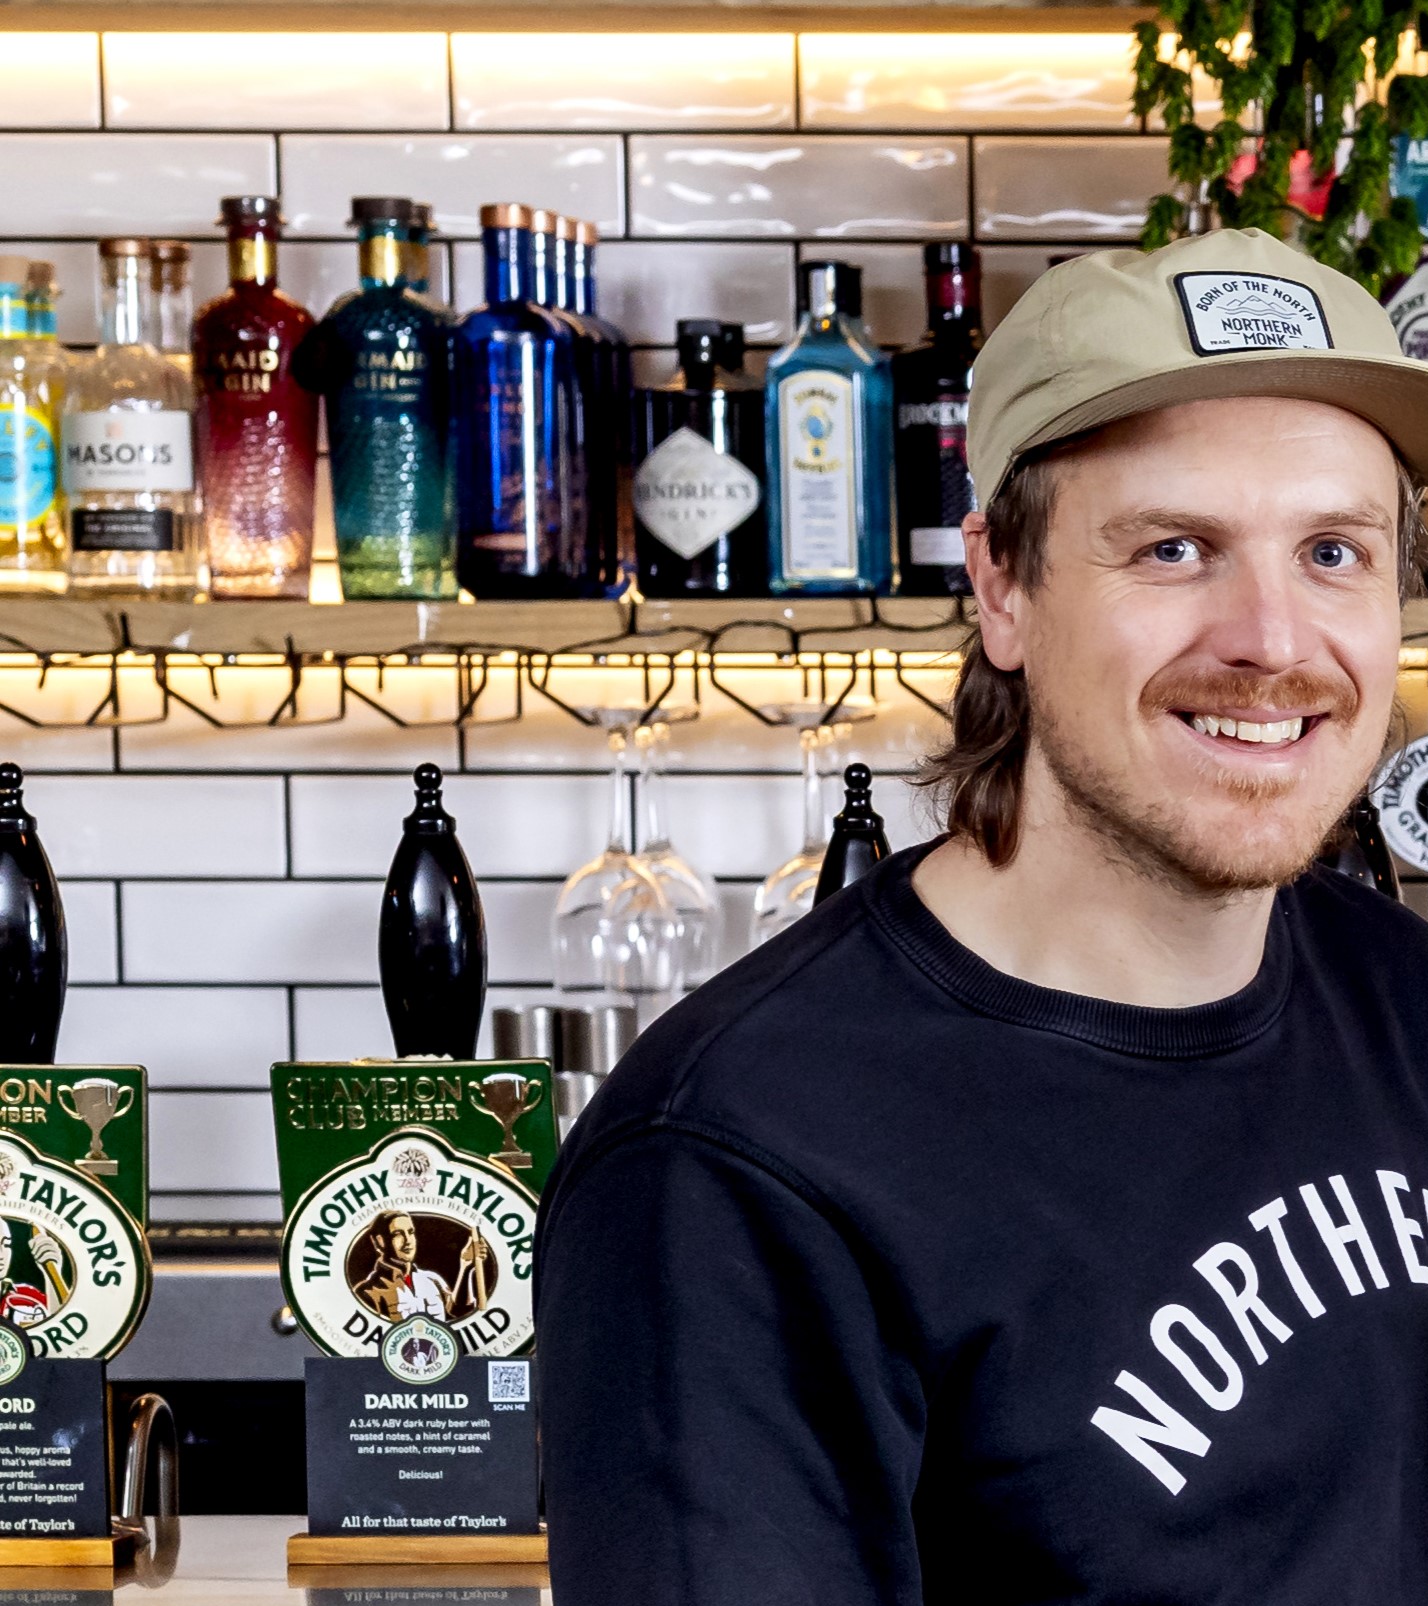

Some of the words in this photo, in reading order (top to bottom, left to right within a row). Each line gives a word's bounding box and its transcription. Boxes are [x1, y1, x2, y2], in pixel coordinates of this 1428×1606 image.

[1196, 286, 1224, 312] BORN
[1222, 281, 1239, 292] OF
[1242, 280, 1269, 293] THE
[1273, 288, 1316, 321] NORTH
[1221, 317, 1303, 336] NORTHERN
[1242, 332, 1289, 347] MONK
[287, 1076, 462, 1102] CHAMPION
[289, 1104, 366, 1129] CLUB
[372, 1103, 460, 1121] MEMBER
[351, 1194, 444, 1227] CHAMPIONSHIP
[447, 1201, 484, 1226] BEERS
[19, 1172, 127, 1287] TAYLOR'S
[302, 1169, 389, 1283] TIMOTHY
[436, 1169, 533, 1280] TAYLORS
[399, 1362, 421, 1376] DARK
[423, 1362, 442, 1376] MILD
[364, 1394, 418, 1409] DARK
[422, 1394, 469, 1409] MILD
[349, 1420, 357, 1428] A
[358, 1420, 380, 1428] 3.4%
[382, 1420, 401, 1428] ABV
[403, 1419, 424, 1428] dark
[426, 1419, 446, 1430] ruby
[448, 1419, 469, 1428] beer
[471, 1419, 490, 1428] with
[350, 1432, 383, 1441] roasted
[386, 1432, 413, 1442] notes,
[423, 1432, 440, 1441] hint
[442, 1432, 452, 1441] of
[453, 1432, 490, 1441] caramel
[15, 1446, 41, 1456] hoppy
[42, 1447, 71, 1455] aroma
[358, 1445, 375, 1454] and
[384, 1445, 421, 1454] smooth,
[423, 1447, 456, 1456] creamy
[458, 1445, 483, 1454] taste.
[2, 1458, 26, 1467] that's
[28, 1458, 72, 1467] well-loved
[399, 1470, 444, 1480] Delicious!
[6, 1482, 15, 1491] of
[17, 1482, 46, 1491] Britain
[56, 1482, 84, 1491] record
[35, 1494, 77, 1504] forgotten!
[14, 1519, 27, 1531] of
[29, 1519, 75, 1532] Taylor's
[342, 1516, 361, 1527] All
[363, 1516, 381, 1527] for
[383, 1516, 408, 1527] that
[410, 1517, 441, 1527] taste
[443, 1516, 458, 1527] of
[459, 1516, 507, 1529] Taylor's
